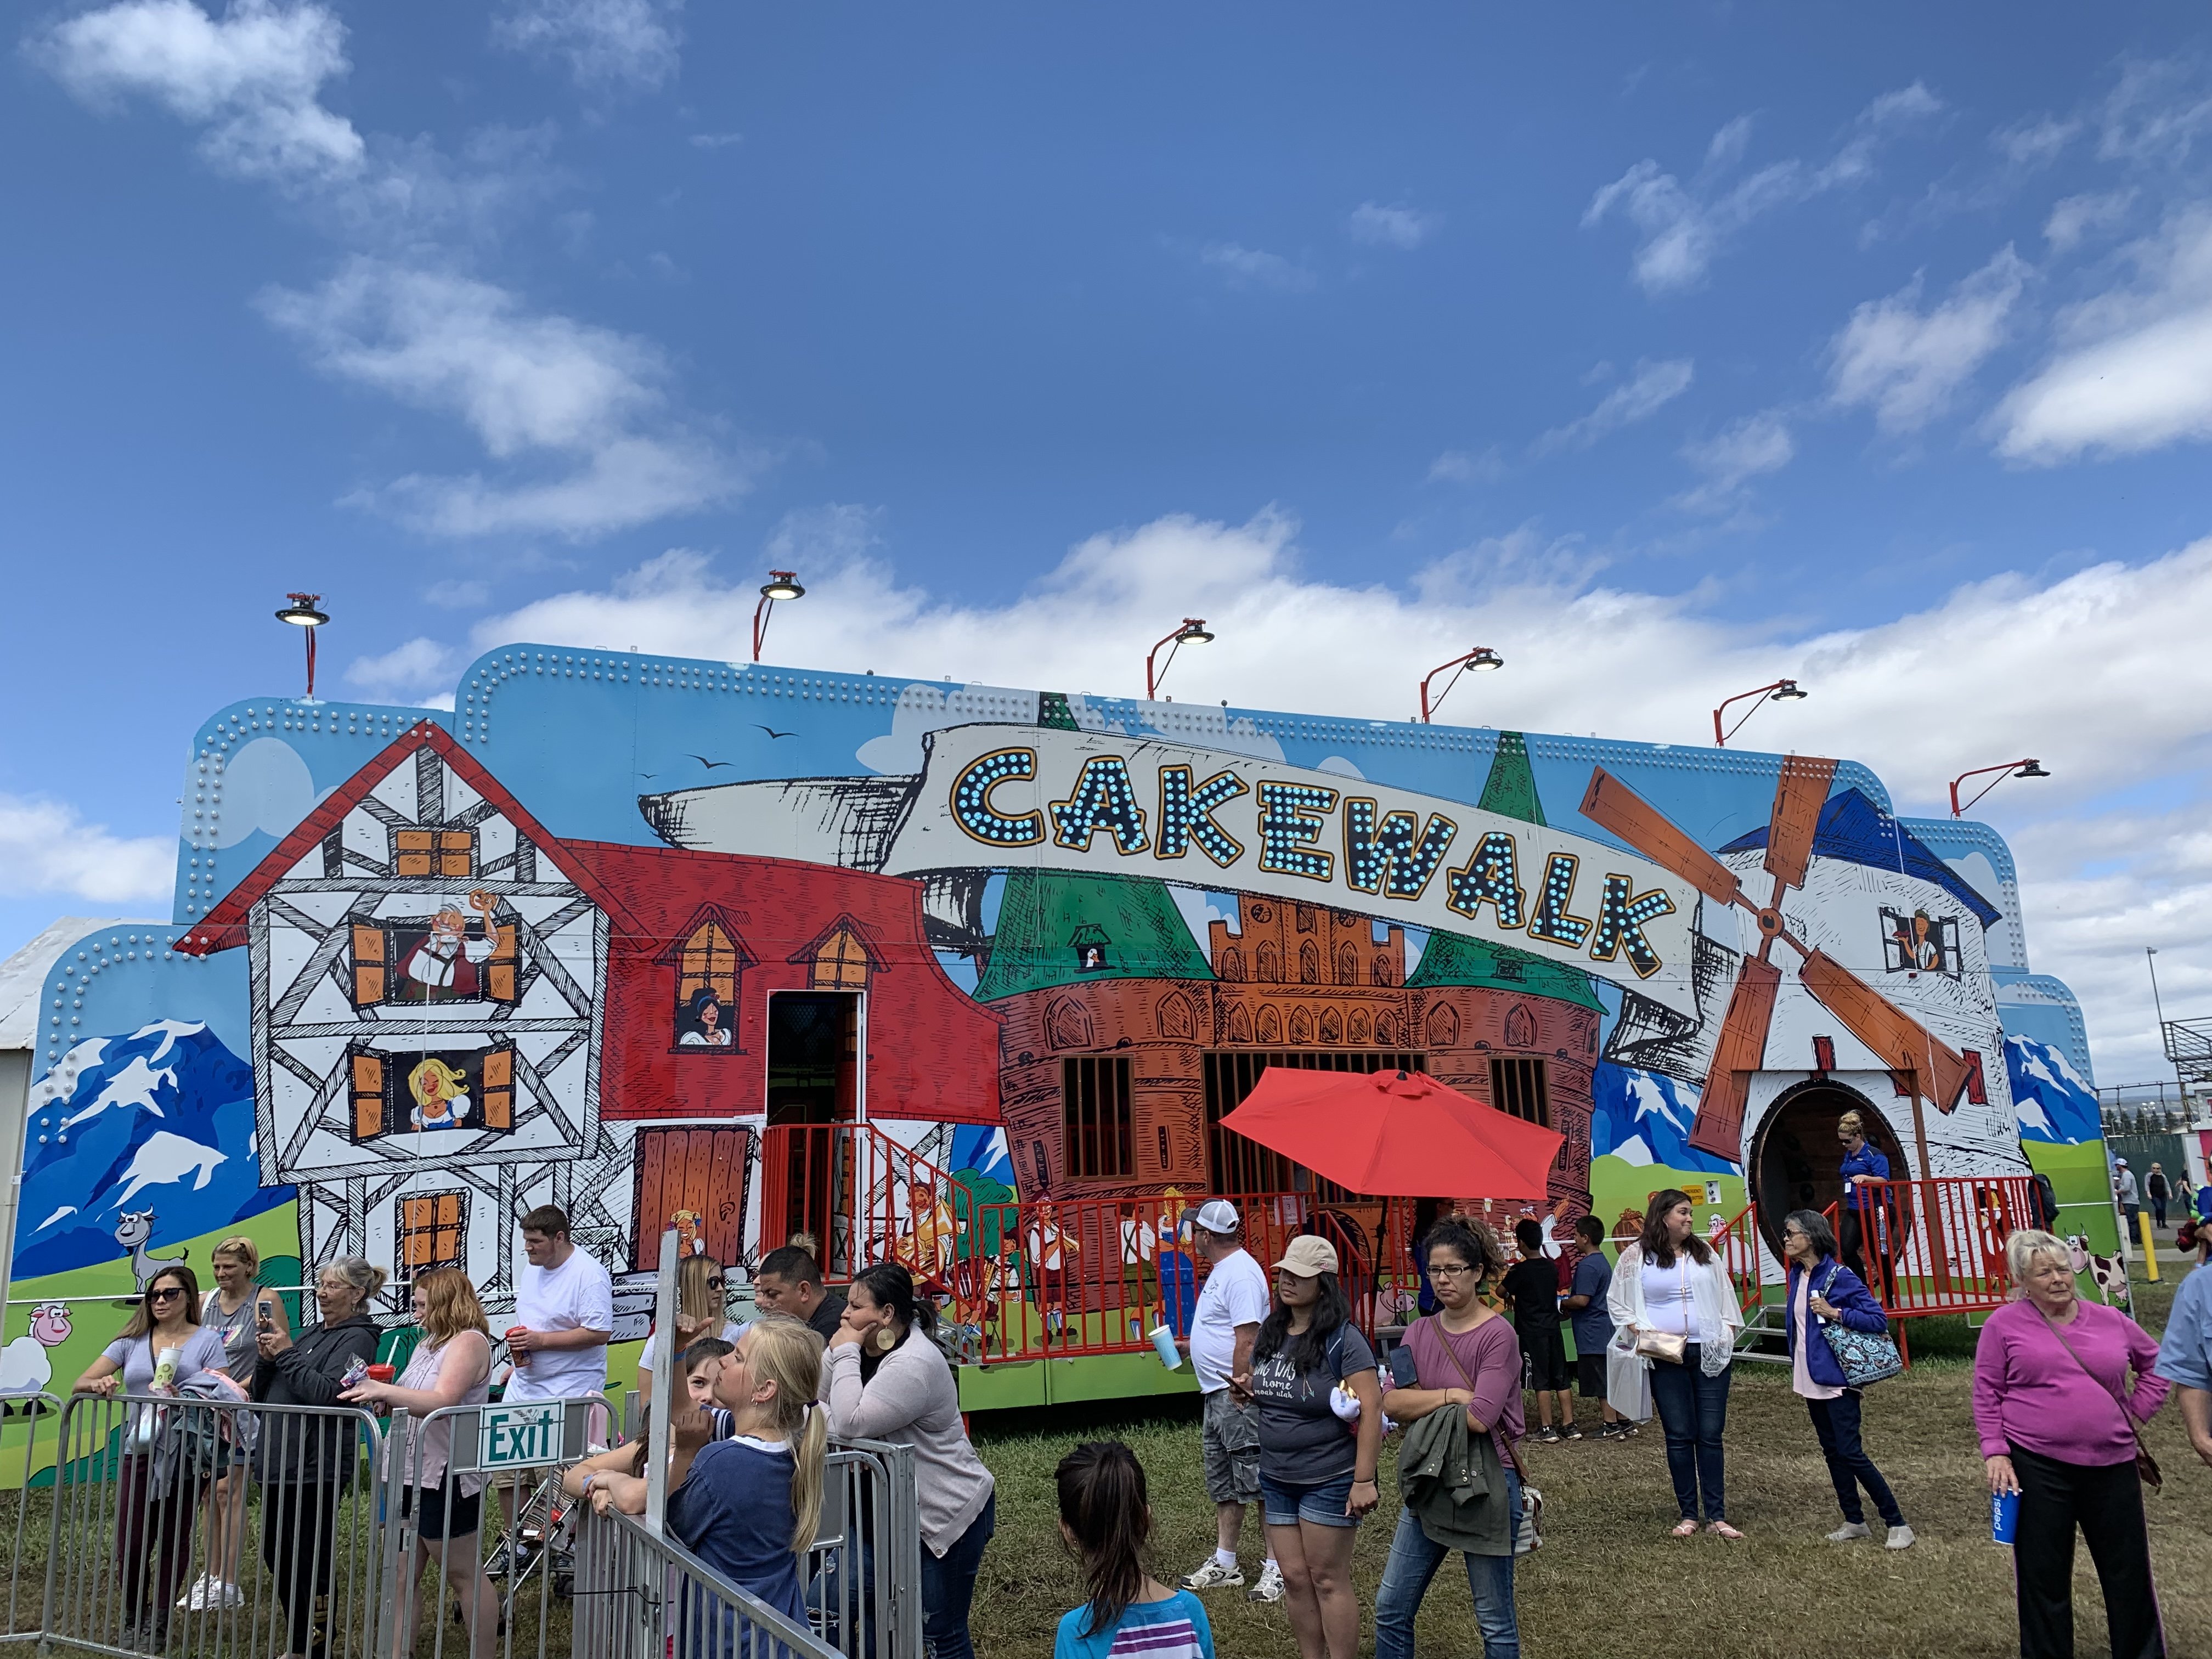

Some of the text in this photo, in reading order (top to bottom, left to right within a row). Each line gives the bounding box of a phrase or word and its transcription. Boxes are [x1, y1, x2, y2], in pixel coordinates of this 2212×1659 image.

[950, 747, 1676, 978] CAKEWALK
[1263, 1378, 1293, 1390] home
[1277, 1390, 1294, 1399] utah
[1993, 1498, 2003, 1531] pepsi
